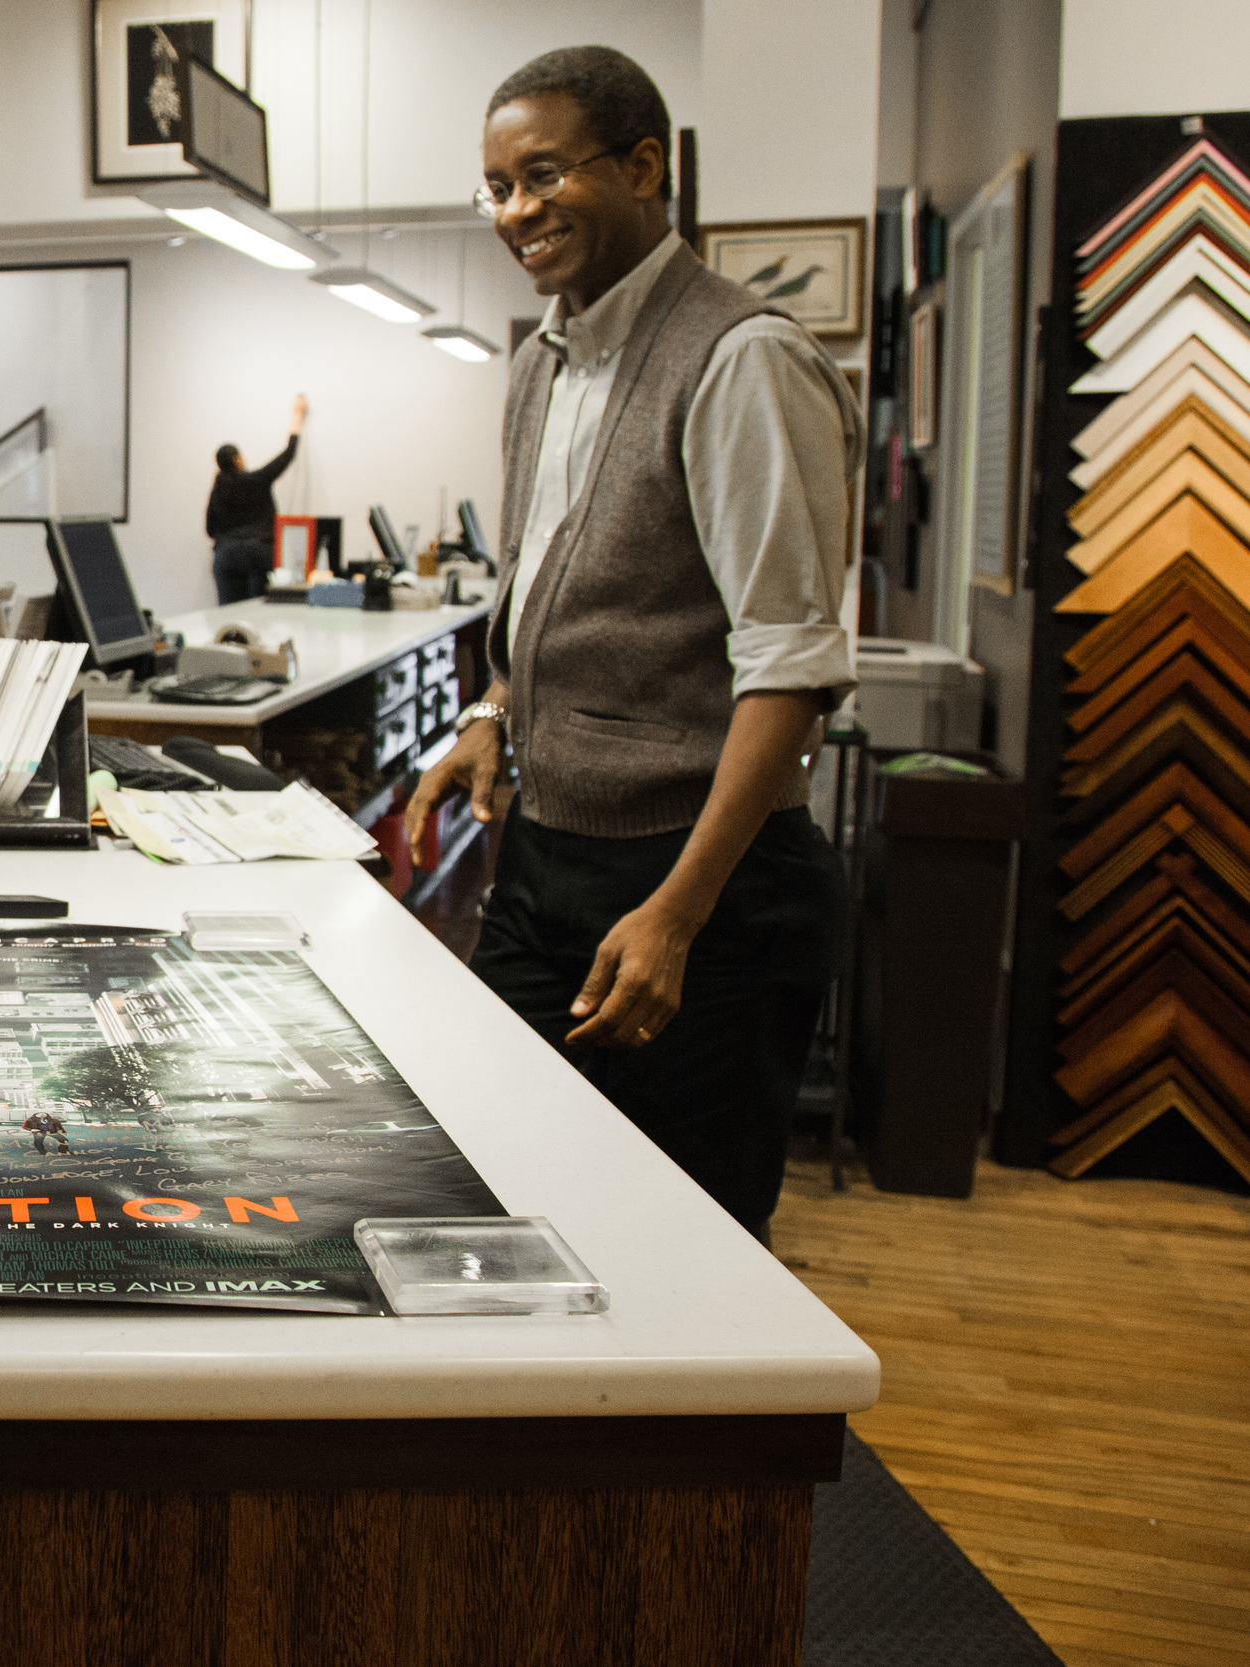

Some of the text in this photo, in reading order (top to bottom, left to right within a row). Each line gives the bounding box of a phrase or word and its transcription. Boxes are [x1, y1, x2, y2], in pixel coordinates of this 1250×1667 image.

[164, 1249, 200, 1260] HANS
[1, 1271, 45, 1281] NOLAN
[126, 1282, 196, 1293] AND
[205, 1280, 324, 1291] IMAX
